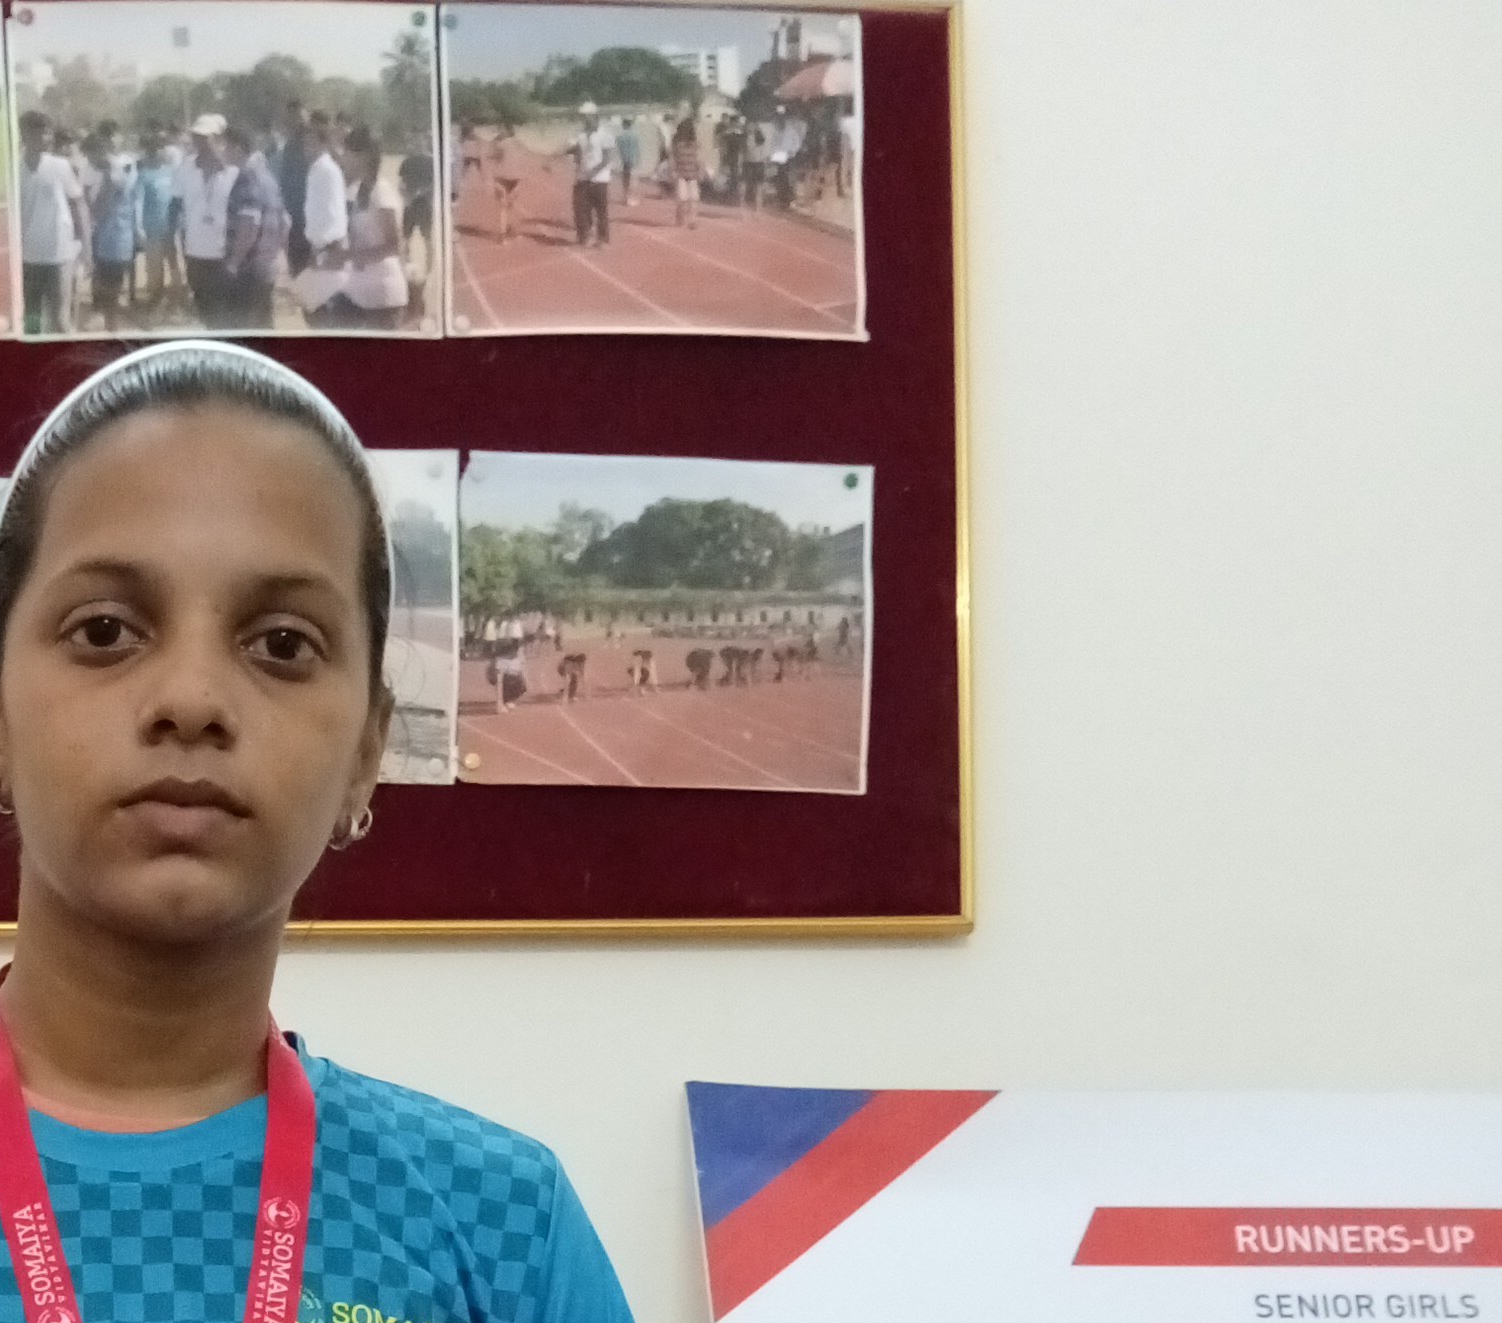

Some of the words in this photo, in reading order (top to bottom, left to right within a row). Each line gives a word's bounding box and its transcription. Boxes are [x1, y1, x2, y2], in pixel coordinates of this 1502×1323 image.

[1235, 1223, 1476, 1255] RUNNERS-UP
[13, 1205, 57, 1307] SOMAIYA
[1254, 1293, 1376, 1320] SENIOR
[1386, 1293, 1481, 1320] GIRLS
